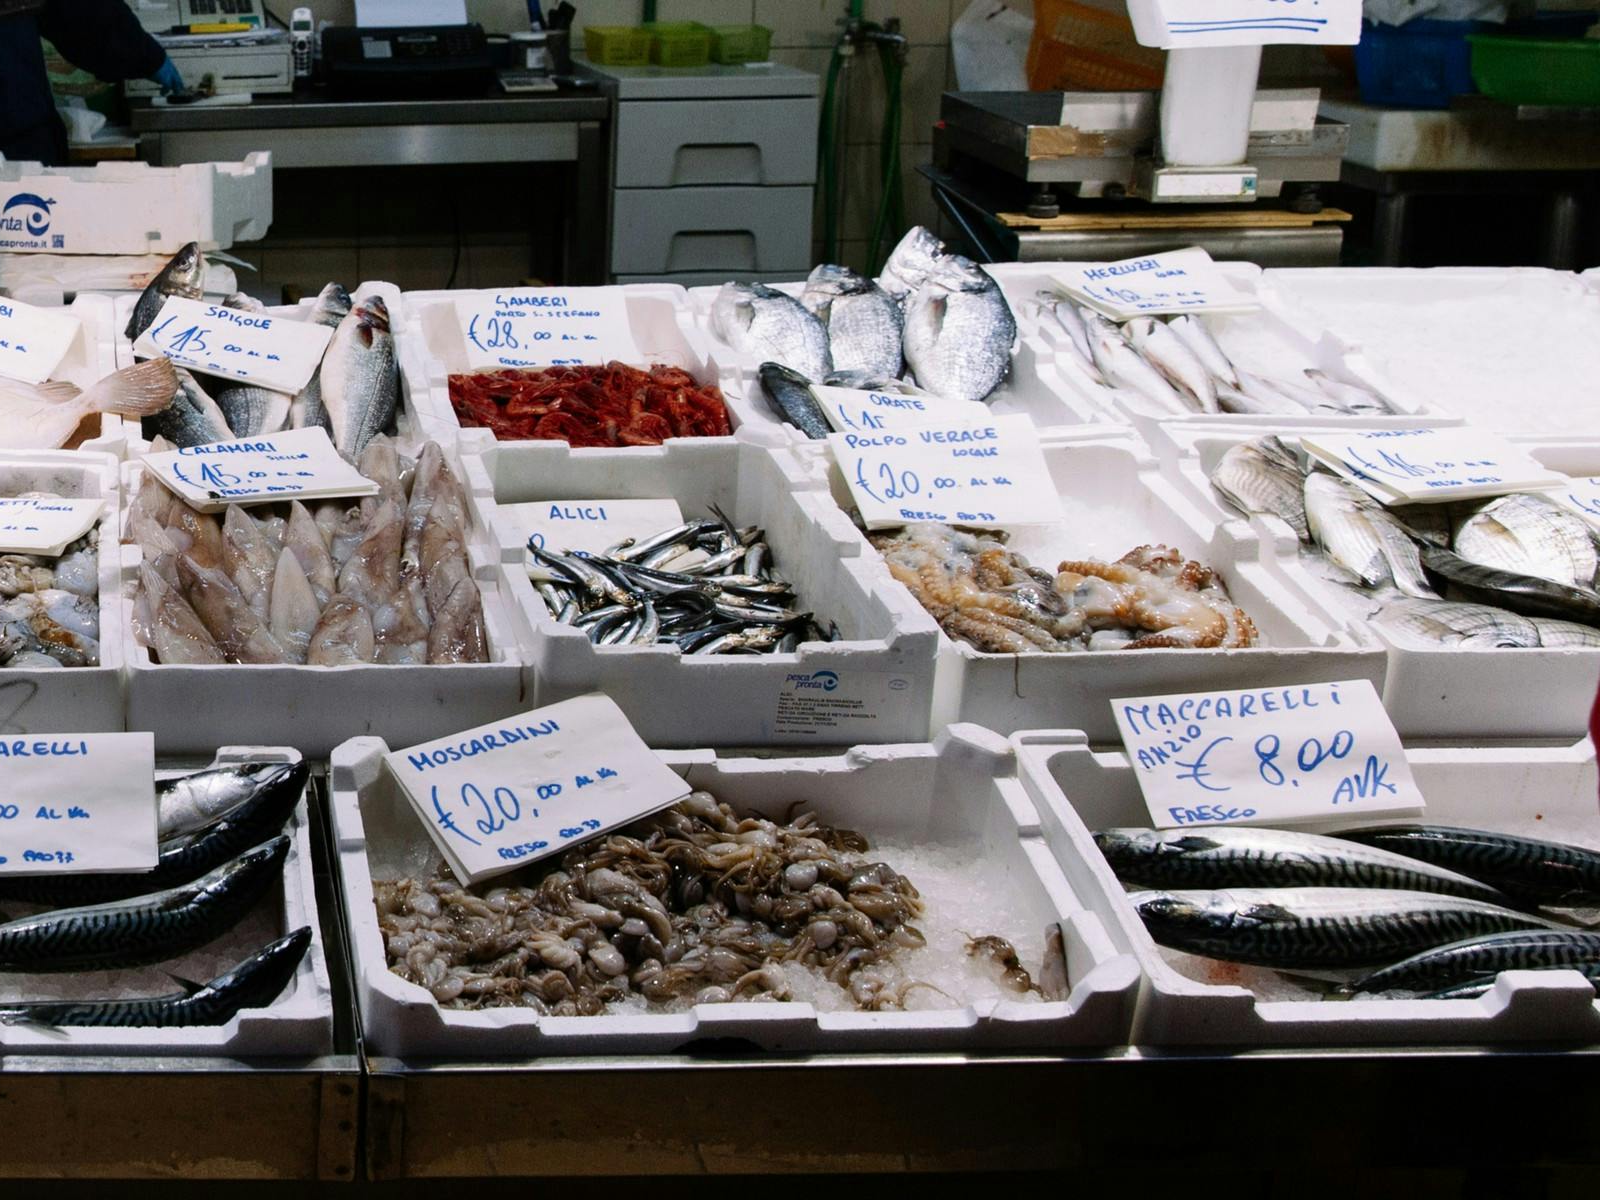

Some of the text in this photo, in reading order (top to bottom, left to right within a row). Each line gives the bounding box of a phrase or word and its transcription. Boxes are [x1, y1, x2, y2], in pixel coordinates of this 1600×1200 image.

[496, 295, 568, 309] GAMBERI
[204, 306, 272, 330] SPIGOLE
[870, 393, 927, 411] ORATE
[845, 428, 998, 449] POLPO VERACE
[178, 442, 277, 456] CALAMARI
[550, 505, 607, 520] ALICI
[786, 673, 810, 682] pesca
[795, 680, 822, 690] pronta
[408, 720, 561, 771] MOSCARDINI
